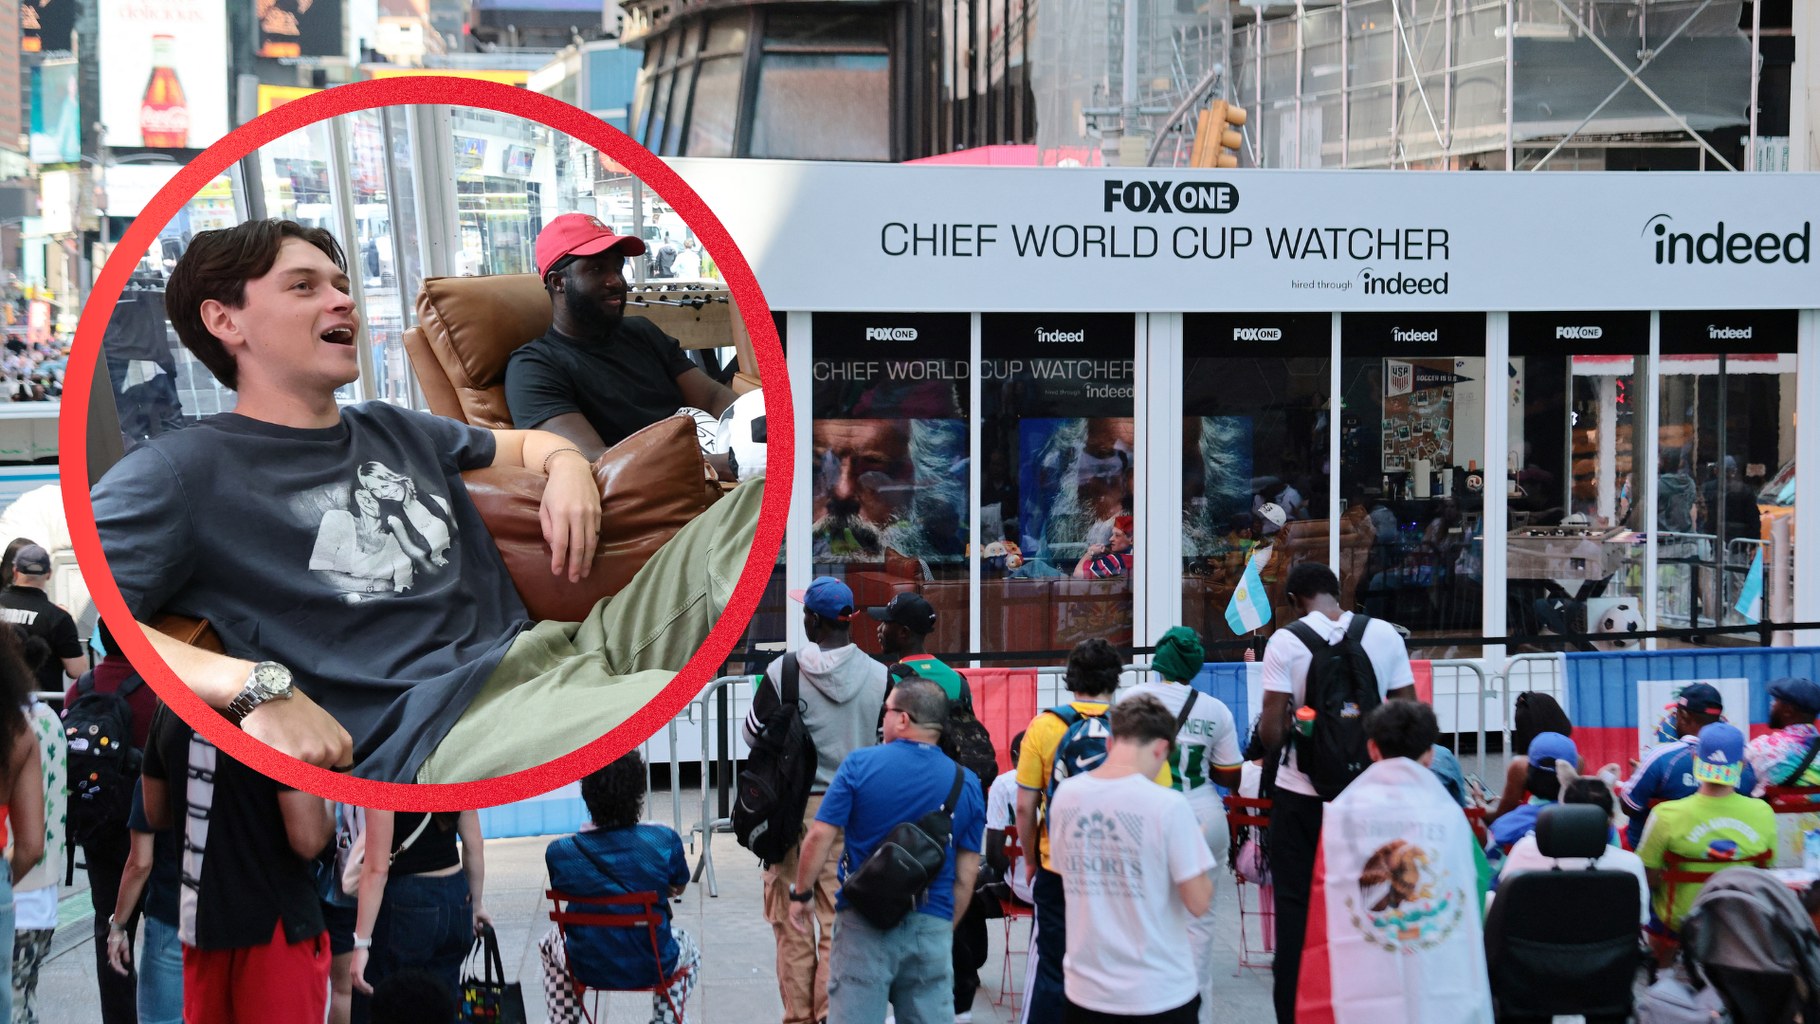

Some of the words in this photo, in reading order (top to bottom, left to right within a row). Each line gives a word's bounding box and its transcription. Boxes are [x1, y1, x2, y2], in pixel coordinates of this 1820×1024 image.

[1104, 180, 1172, 214] FOX
[1178, 187, 1232, 211] ONE
[881, 222, 998, 257] CHIEF
[1011, 224, 1159, 260] WORLD
[1172, 226, 1253, 260] CUP
[1265, 226, 1450, 261] WATCHER
[1642, 213, 1811, 265] indeed
[1291, 278, 1315, 289] hired
[1317, 278, 1353, 292] through
[1357, 267, 1449, 296] indeed
[866, 327, 892, 341] FOX
[895, 329, 917, 339] ONE
[1034, 327, 1084, 343] indeed
[1233, 327, 1259, 341] FOX
[1261, 329, 1280, 339] ONE
[1391, 326, 1438, 342] indeed
[1556, 327, 1580, 339] FOX
[1582, 328, 1600, 338] ONE
[1707, 324, 1752, 340] indeed
[813, 361, 879, 381] CHIEF
[886, 360, 969, 380] WORLD
[982, 360, 1023, 380] CUP
[1029, 360, 1134, 380] WATCHER
[1392, 367, 1409, 377] USA
